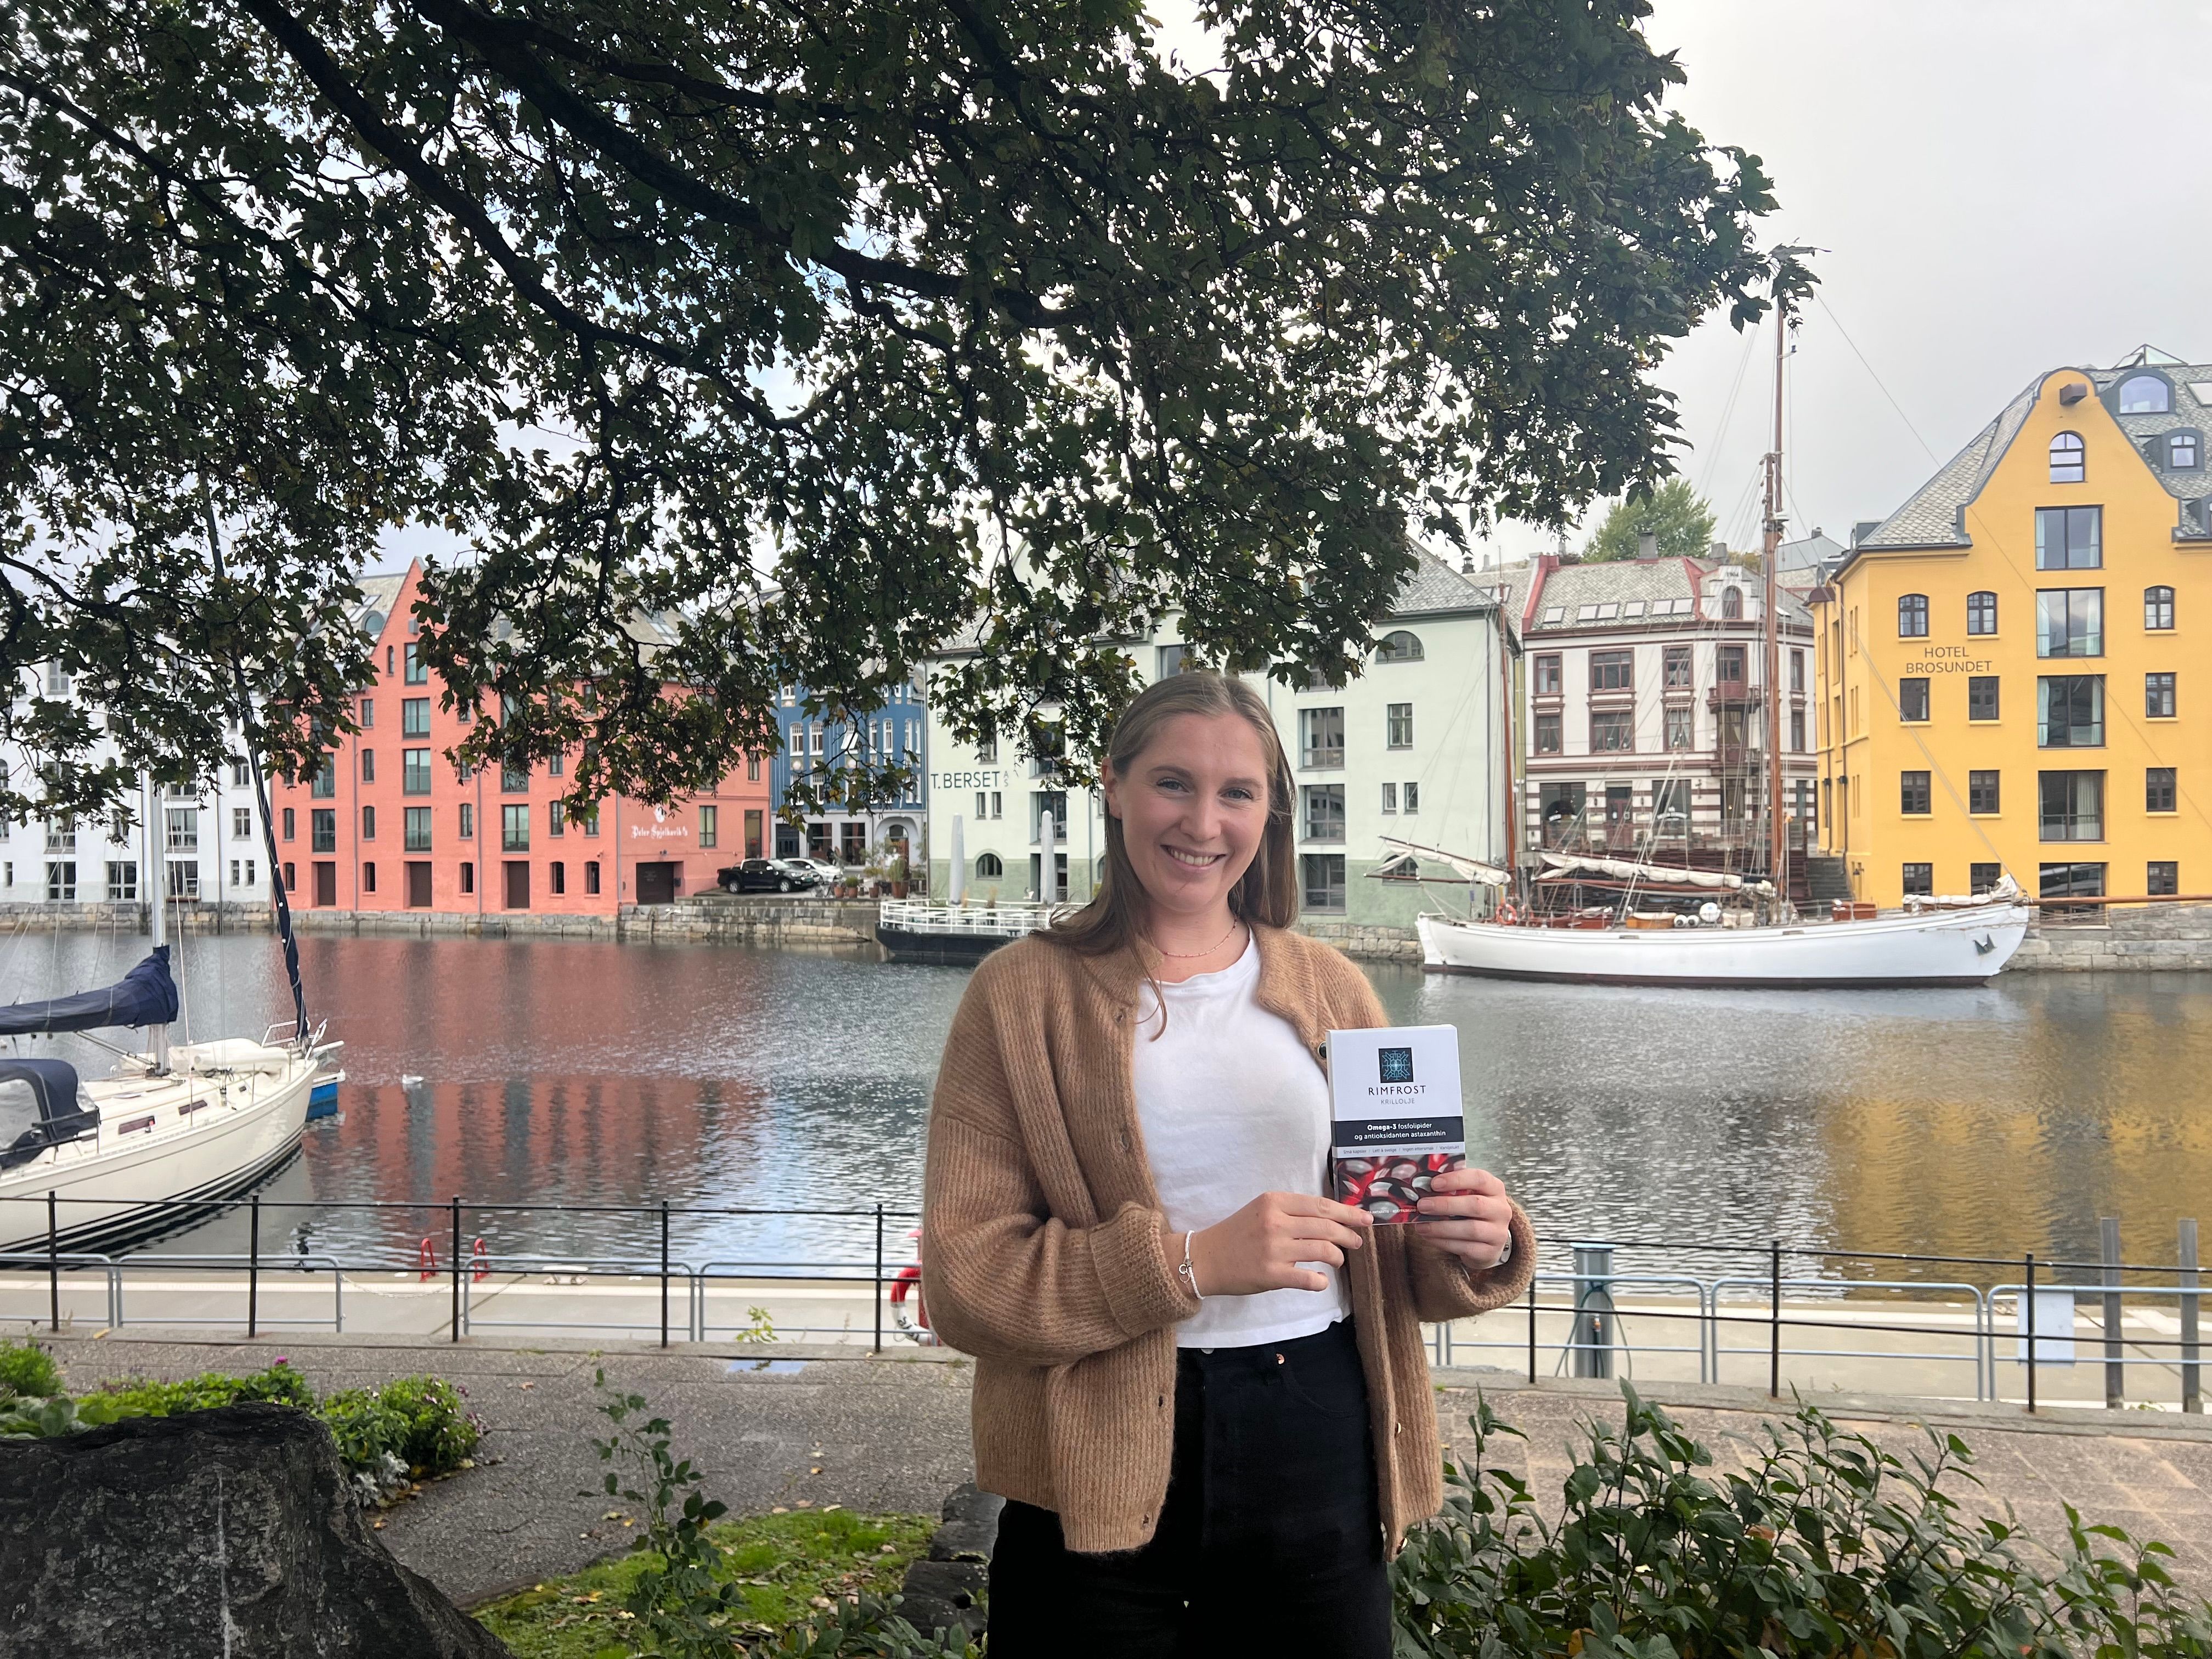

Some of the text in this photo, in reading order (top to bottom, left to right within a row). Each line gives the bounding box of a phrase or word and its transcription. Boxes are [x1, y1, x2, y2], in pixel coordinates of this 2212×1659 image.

[1925, 646, 1970, 658] HOTEL
[1906, 661, 1993, 674] BROSUNDET
[1368, 1085, 1426, 1096] RIMFROST
[1367, 1123, 1397, 1131] Omega-3
